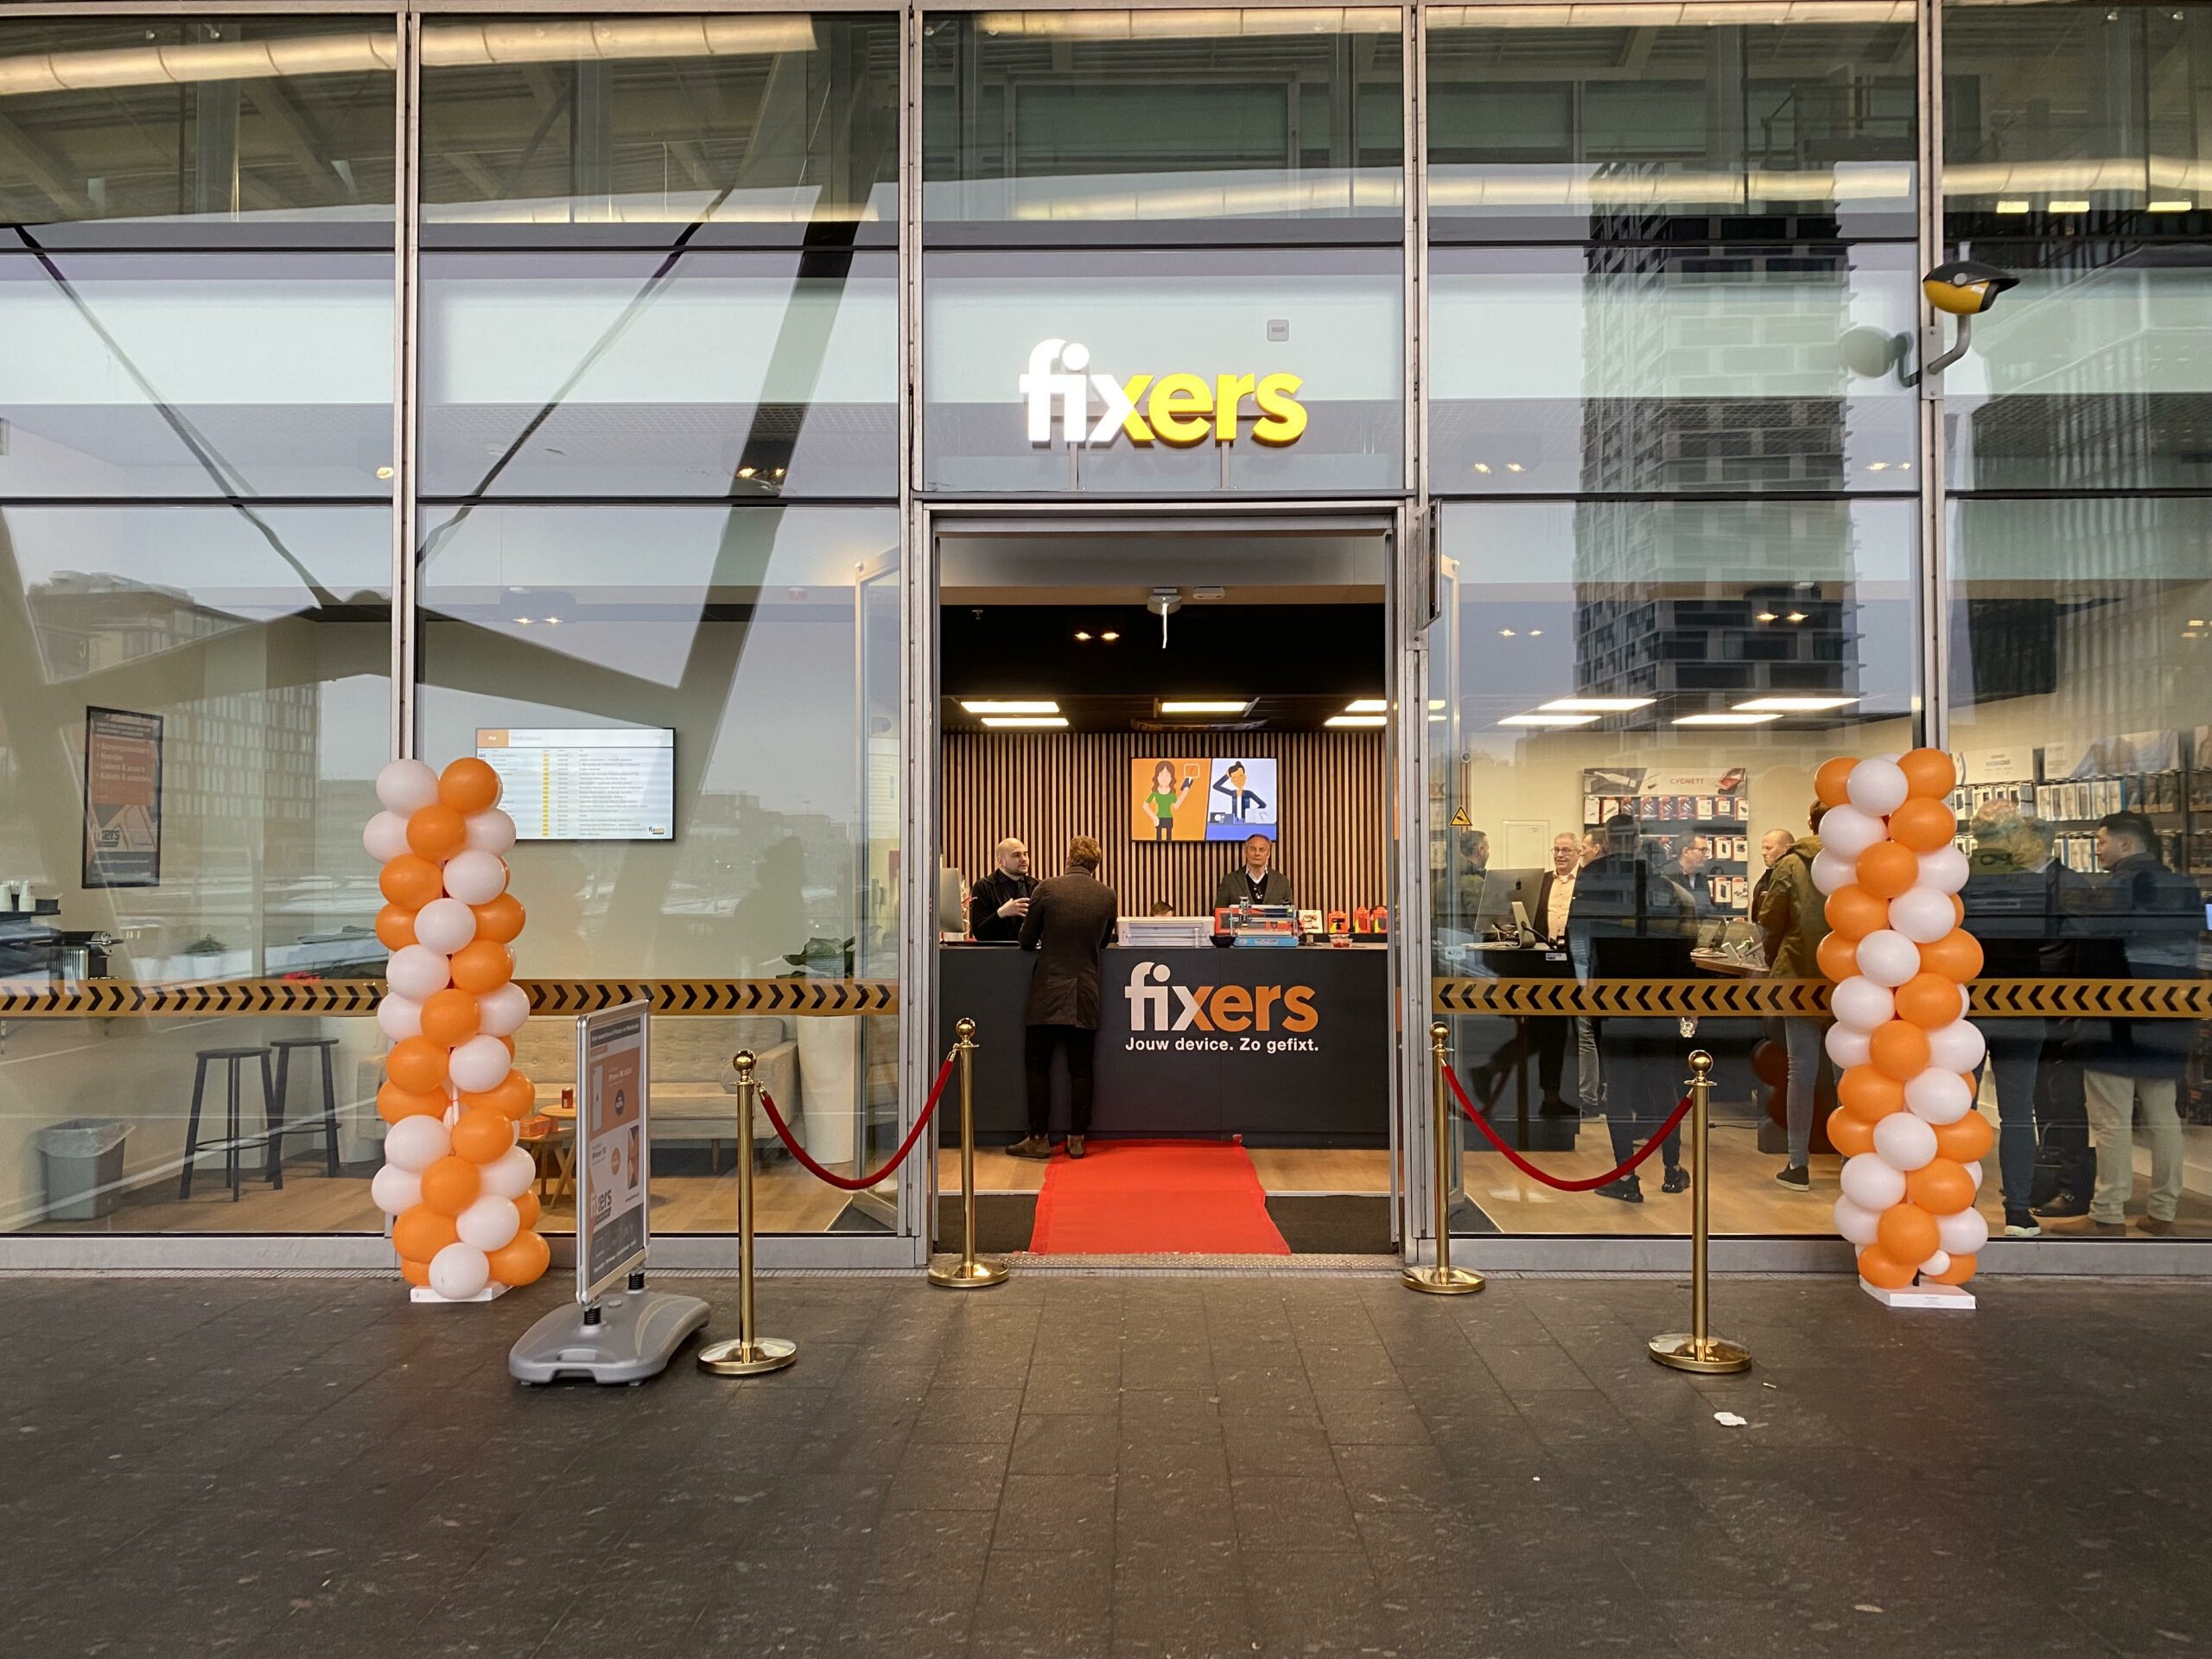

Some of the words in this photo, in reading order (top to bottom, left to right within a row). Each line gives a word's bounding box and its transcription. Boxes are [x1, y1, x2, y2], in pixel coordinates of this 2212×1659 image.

[1020, 338, 1307, 442] fixers
[1125, 962, 1319, 1033] fixers
[1125, 1038, 1169, 1051] Jouw
[1175, 1038, 1233, 1051] device.
[1240, 1038, 1261, 1051] Zo
[1267, 1038, 1319, 1053] gefixt.
